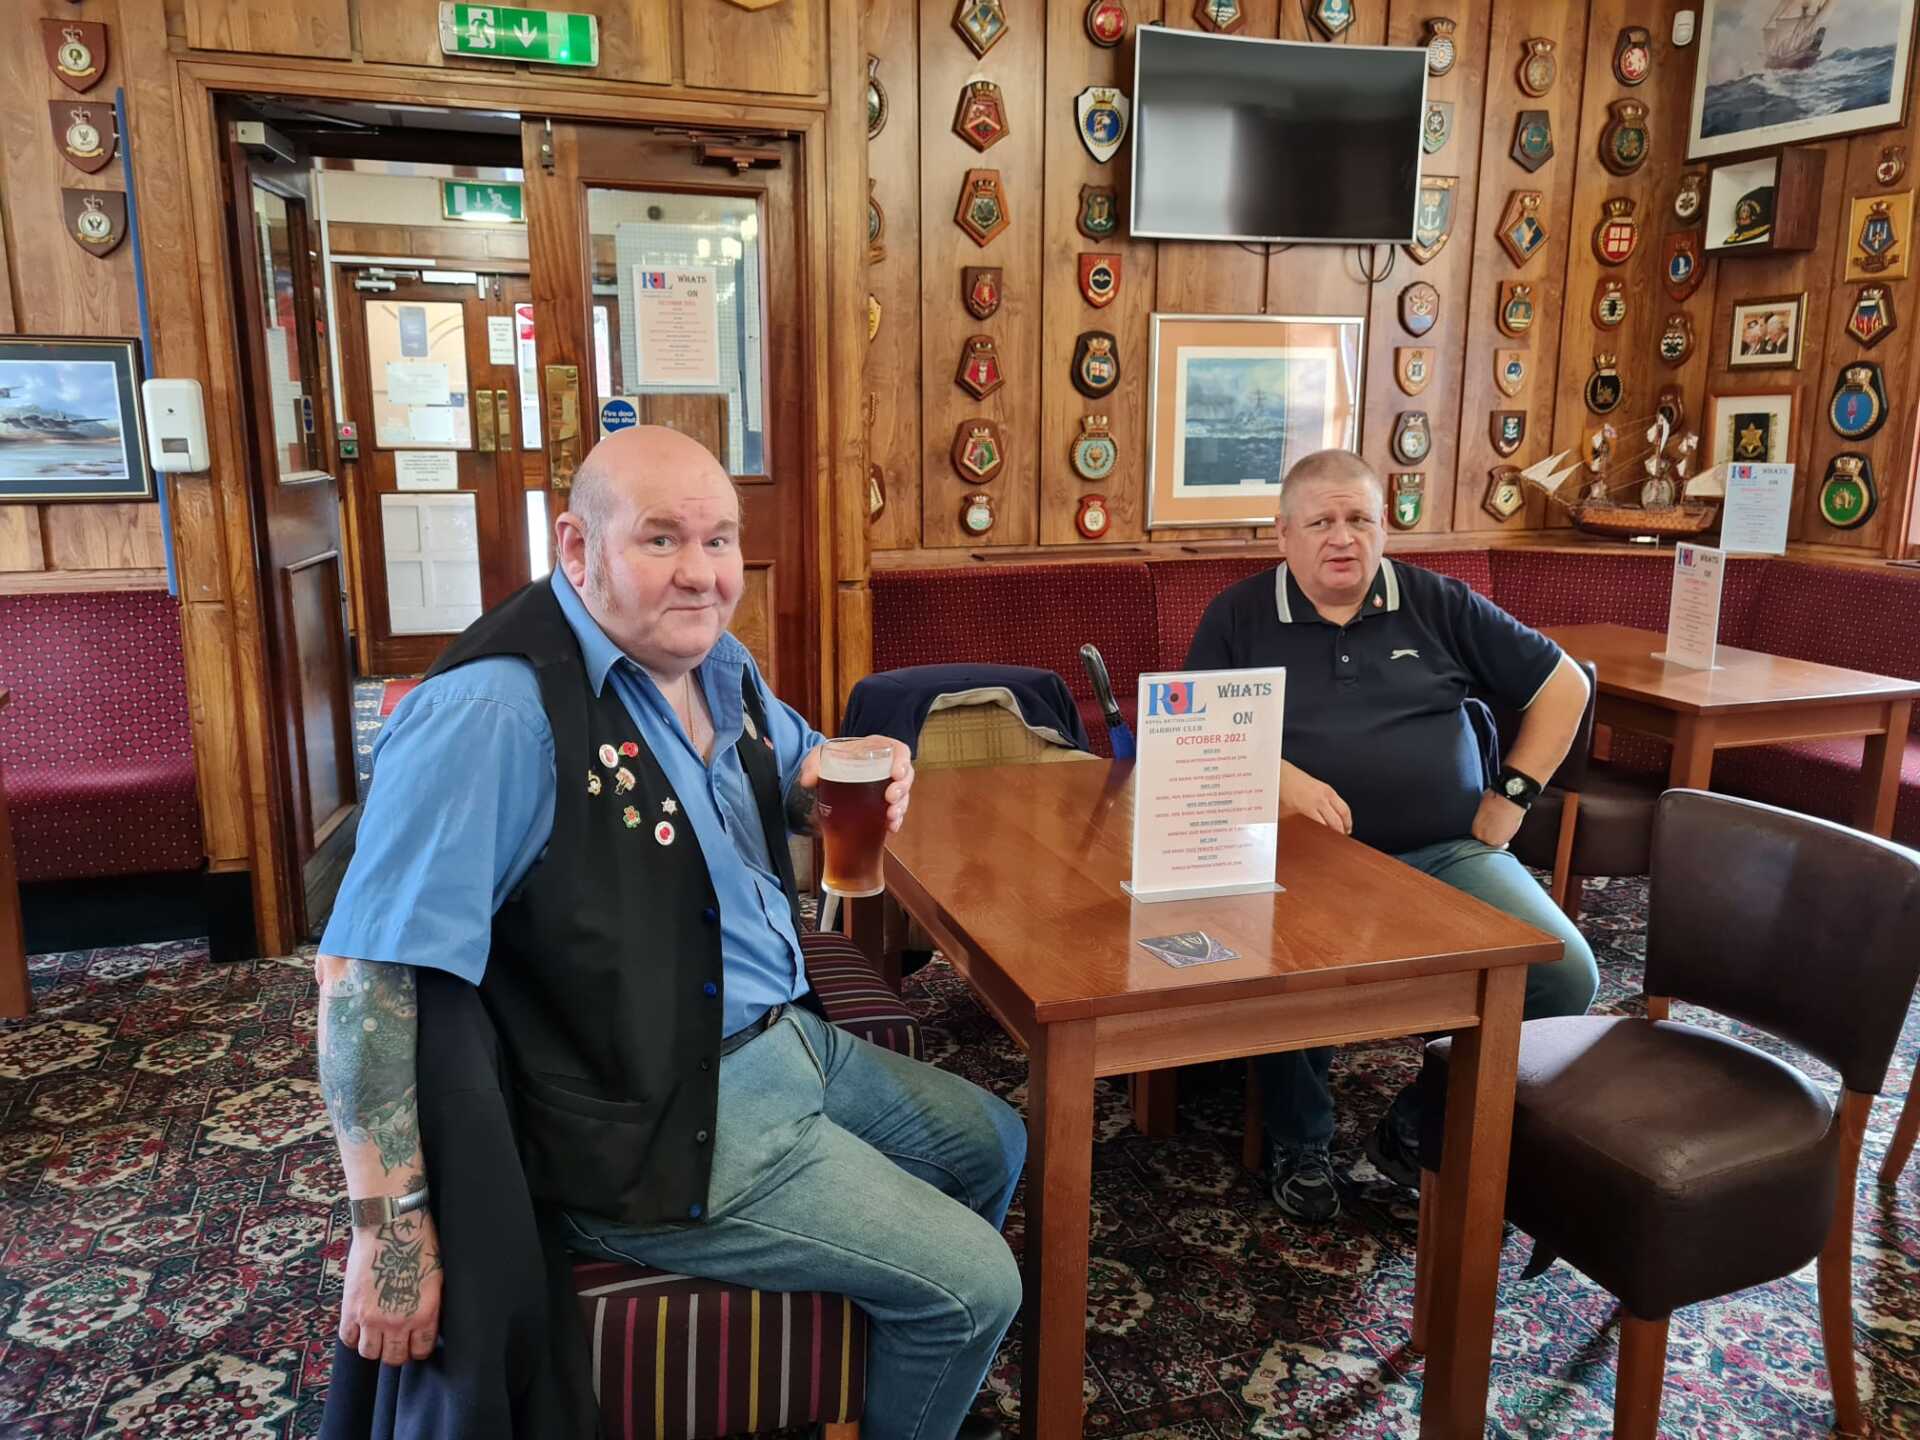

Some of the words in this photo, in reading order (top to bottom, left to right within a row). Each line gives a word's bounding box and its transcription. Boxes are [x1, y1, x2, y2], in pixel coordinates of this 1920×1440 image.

[677, 274, 707, 284] WHATS
[687, 290, 698, 298] ON
[603, 409, 617, 417] Fire
[618, 409, 634, 417] door
[1217, 682, 1272, 699] WHATS
[1233, 711, 1253, 725] ON
[1176, 734, 1221, 746] OCTOBER
[1224, 732, 1247, 743] 2021
